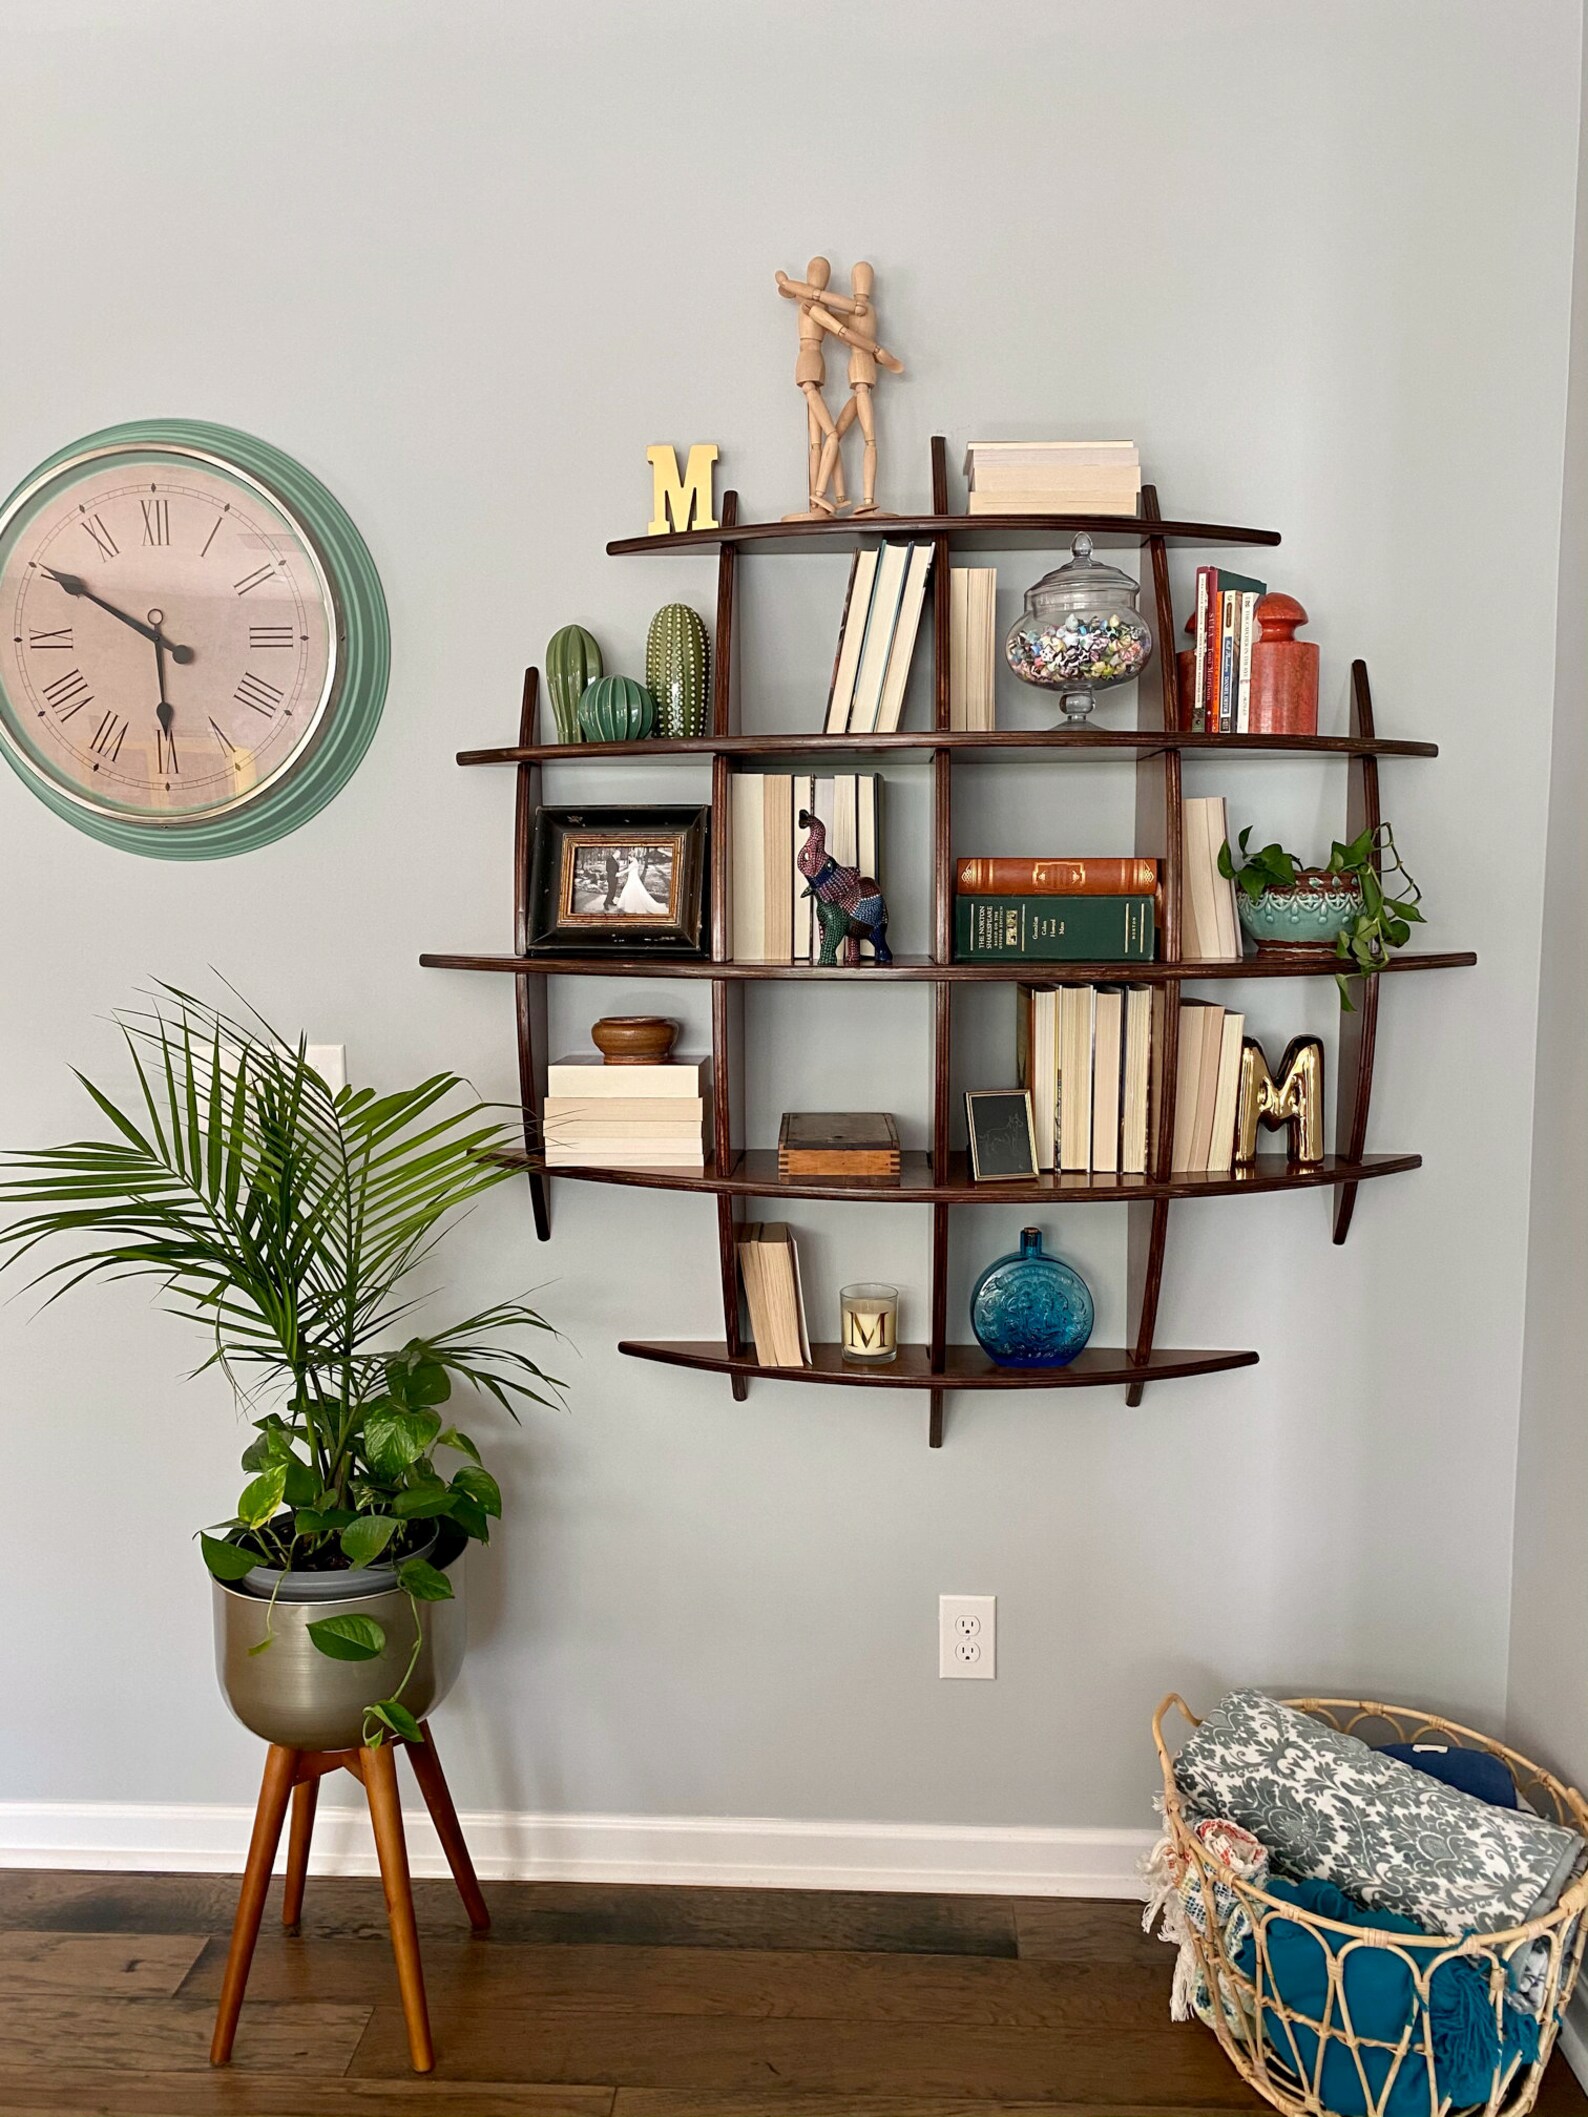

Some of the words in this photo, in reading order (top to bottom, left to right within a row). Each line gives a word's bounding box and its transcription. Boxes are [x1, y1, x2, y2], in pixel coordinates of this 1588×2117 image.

[646, 444, 719, 536] M
[81, 514, 120, 563] XI
[140, 500, 170, 546] XII
[233, 563, 275, 595] II
[249, 626, 293, 648] III
[1232, 1034, 1324, 1165] M
[848, 1310, 889, 1348] M
